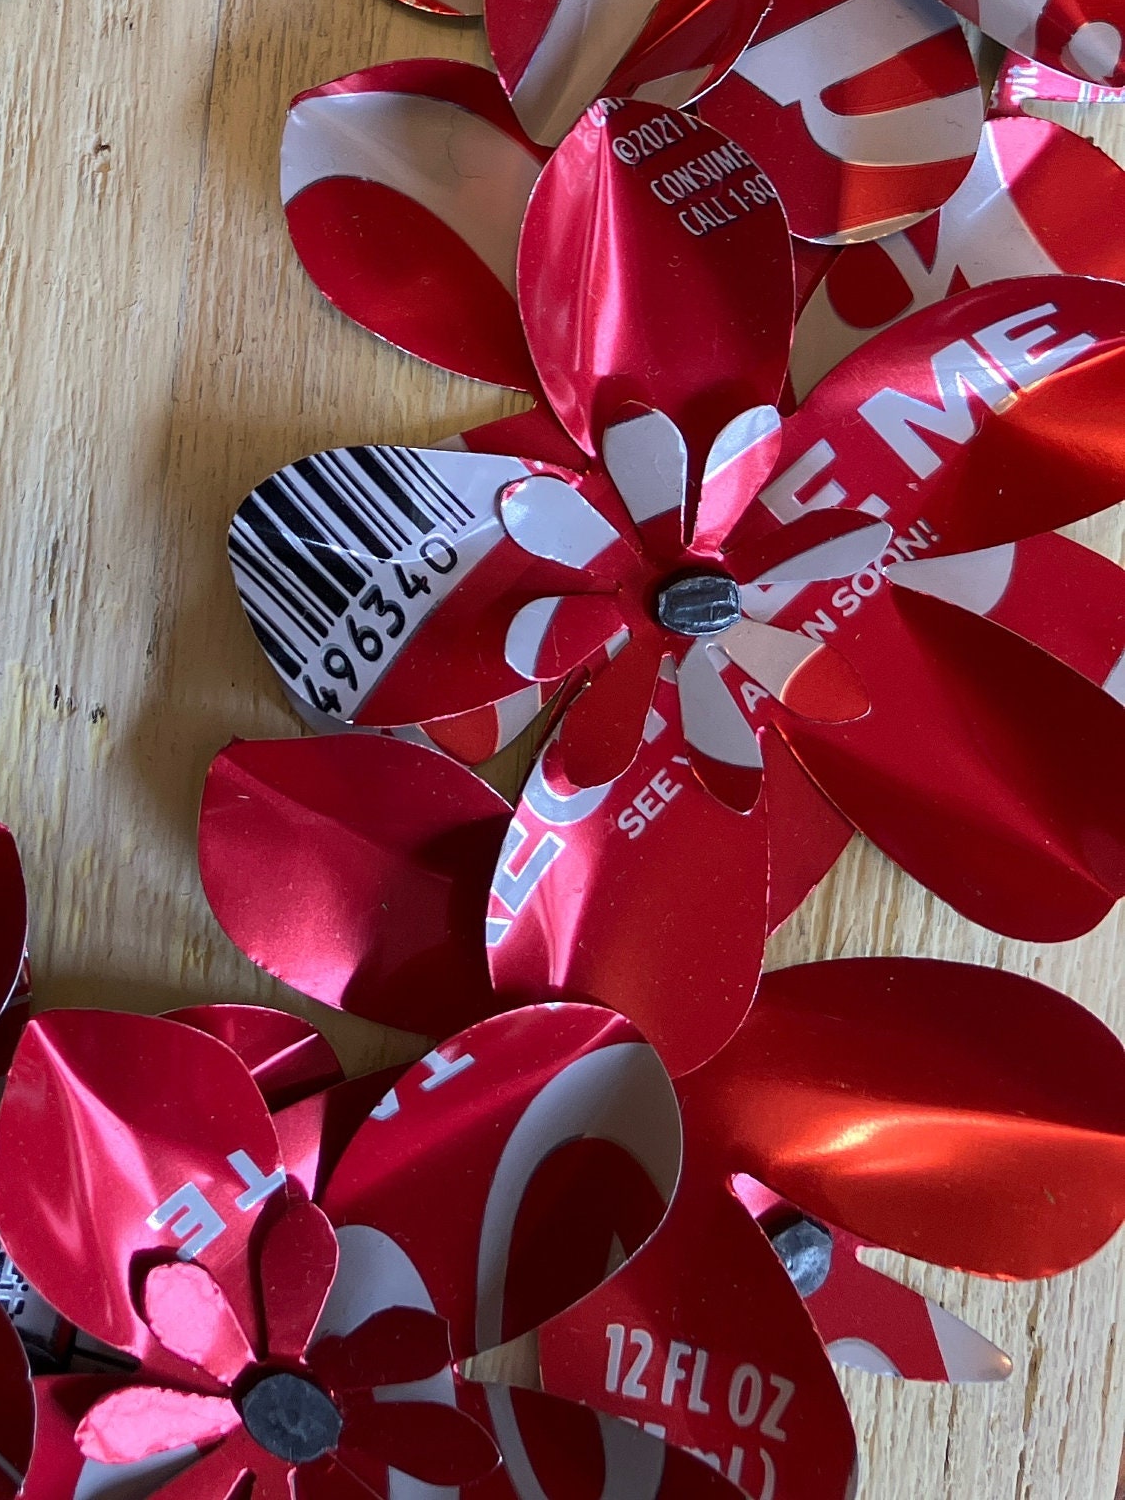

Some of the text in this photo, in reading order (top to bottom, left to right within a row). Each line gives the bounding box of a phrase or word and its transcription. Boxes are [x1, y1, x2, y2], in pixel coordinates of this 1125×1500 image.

[678, 194, 736, 238] CALL
[858, 303, 1097, 480] ME
[302, 534, 458, 713] 496340
[616, 770, 683, 839] SEE
[606, 1322, 797, 1443] 12 FL OZ
